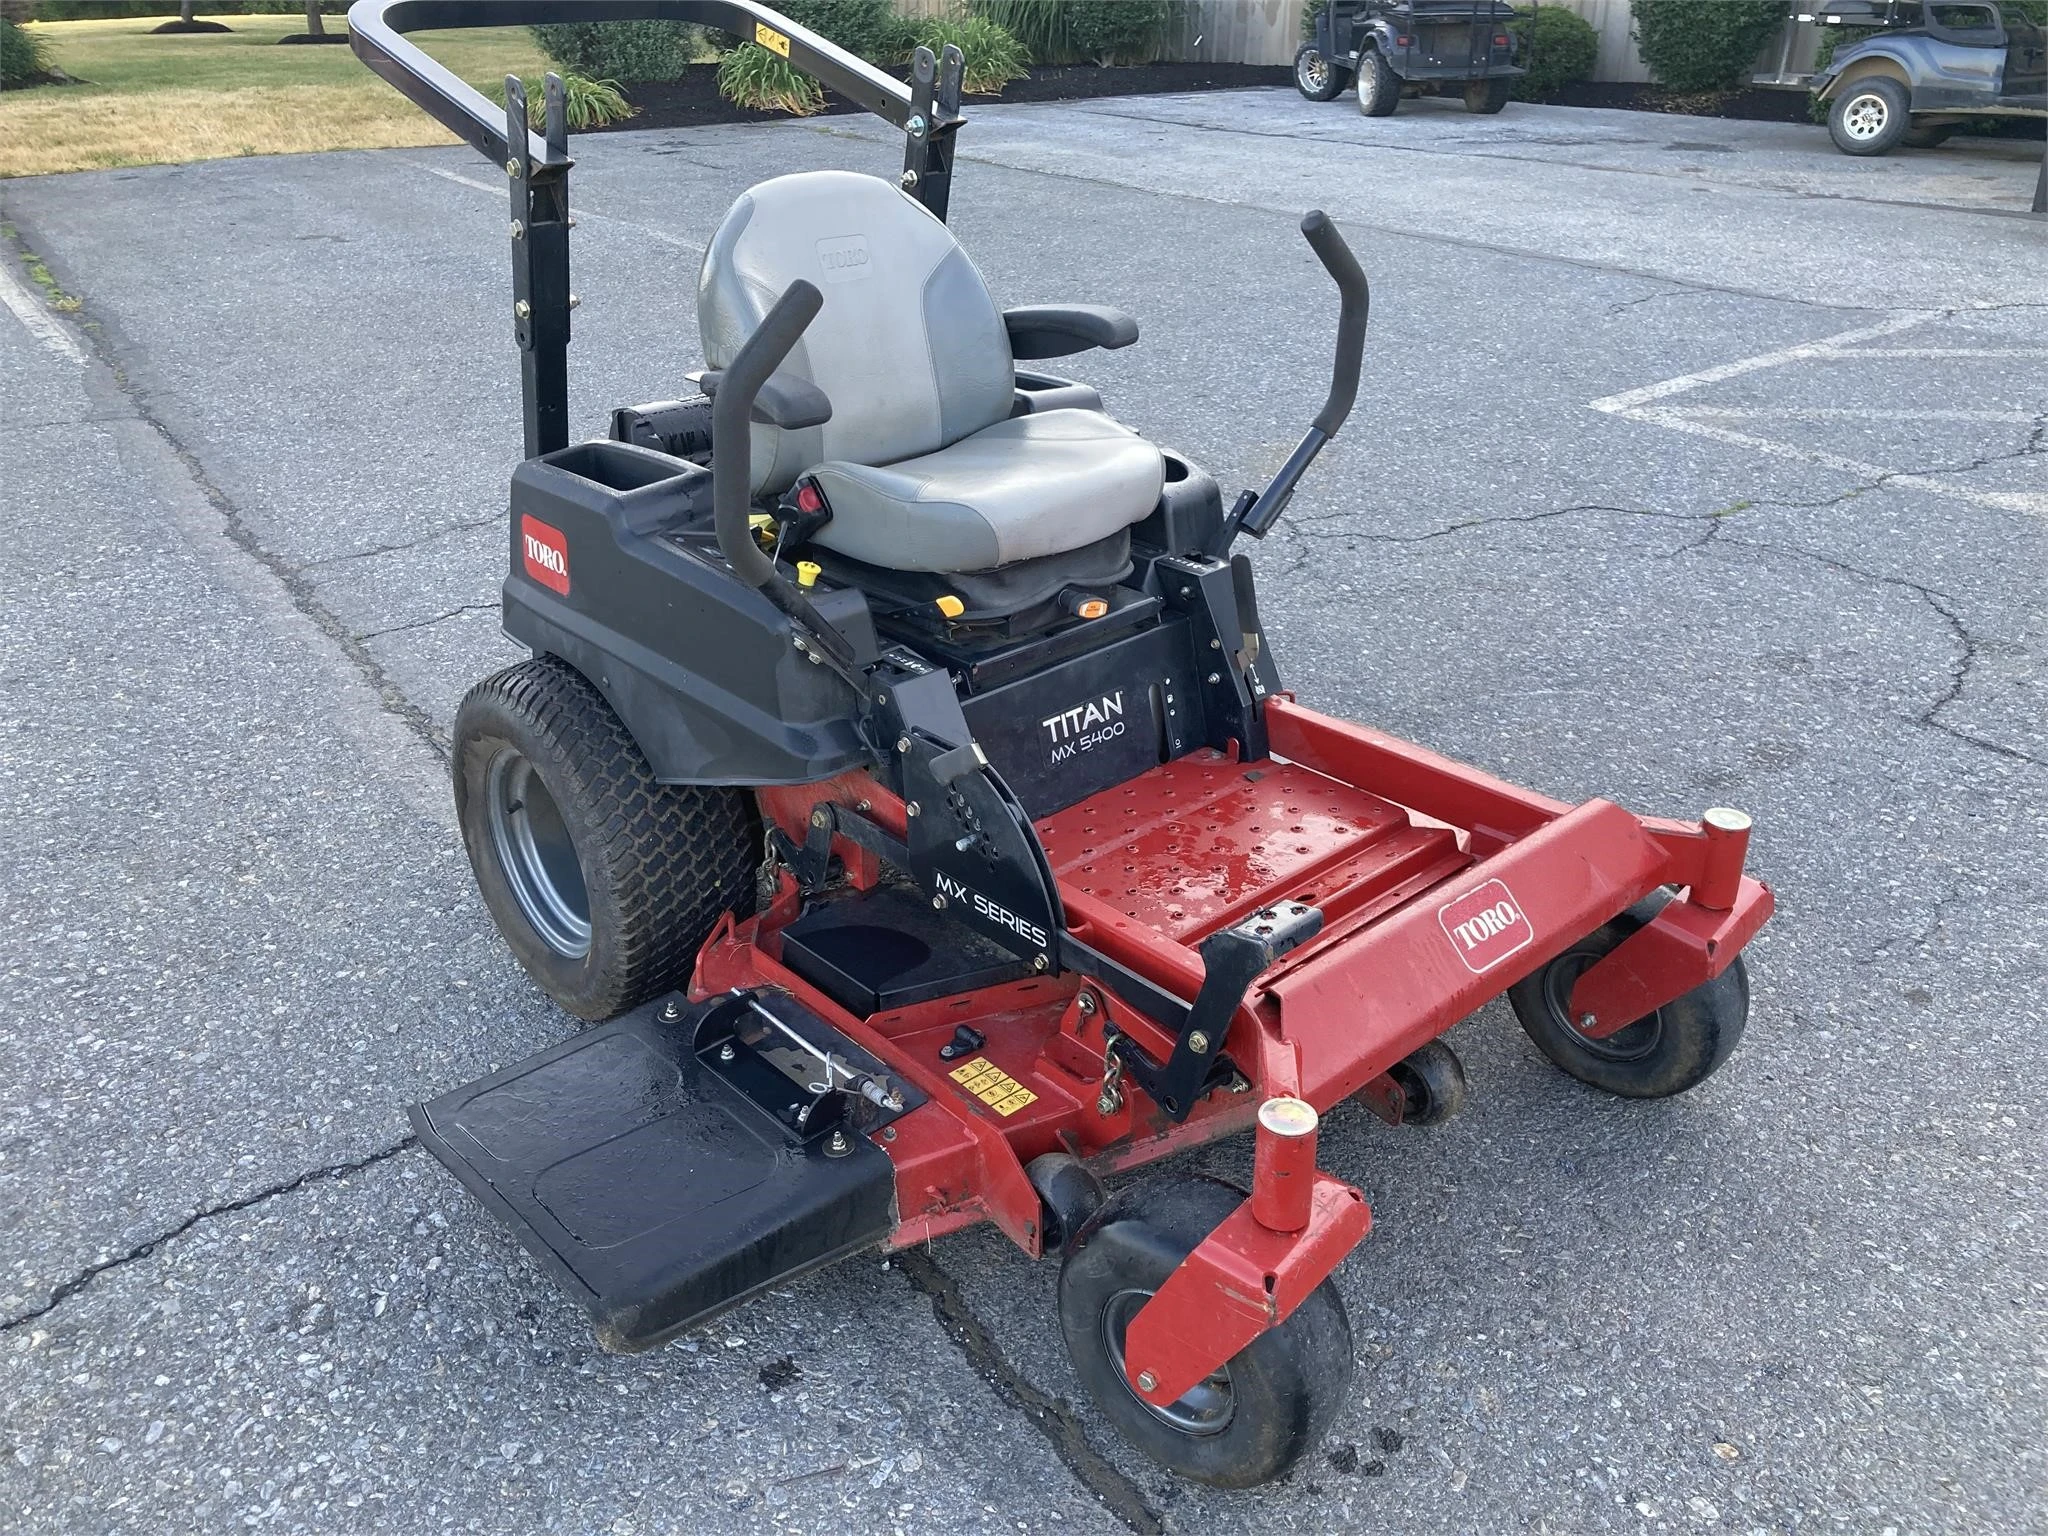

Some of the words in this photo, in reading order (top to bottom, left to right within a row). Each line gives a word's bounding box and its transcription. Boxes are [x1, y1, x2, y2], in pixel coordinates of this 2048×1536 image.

[1042, 691, 1124, 743] TITAN
[1051, 741, 1077, 764] MX
[1079, 721, 1126, 751] 5400
[936, 872, 968, 904] MX
[973, 893, 1048, 949] SERIES
